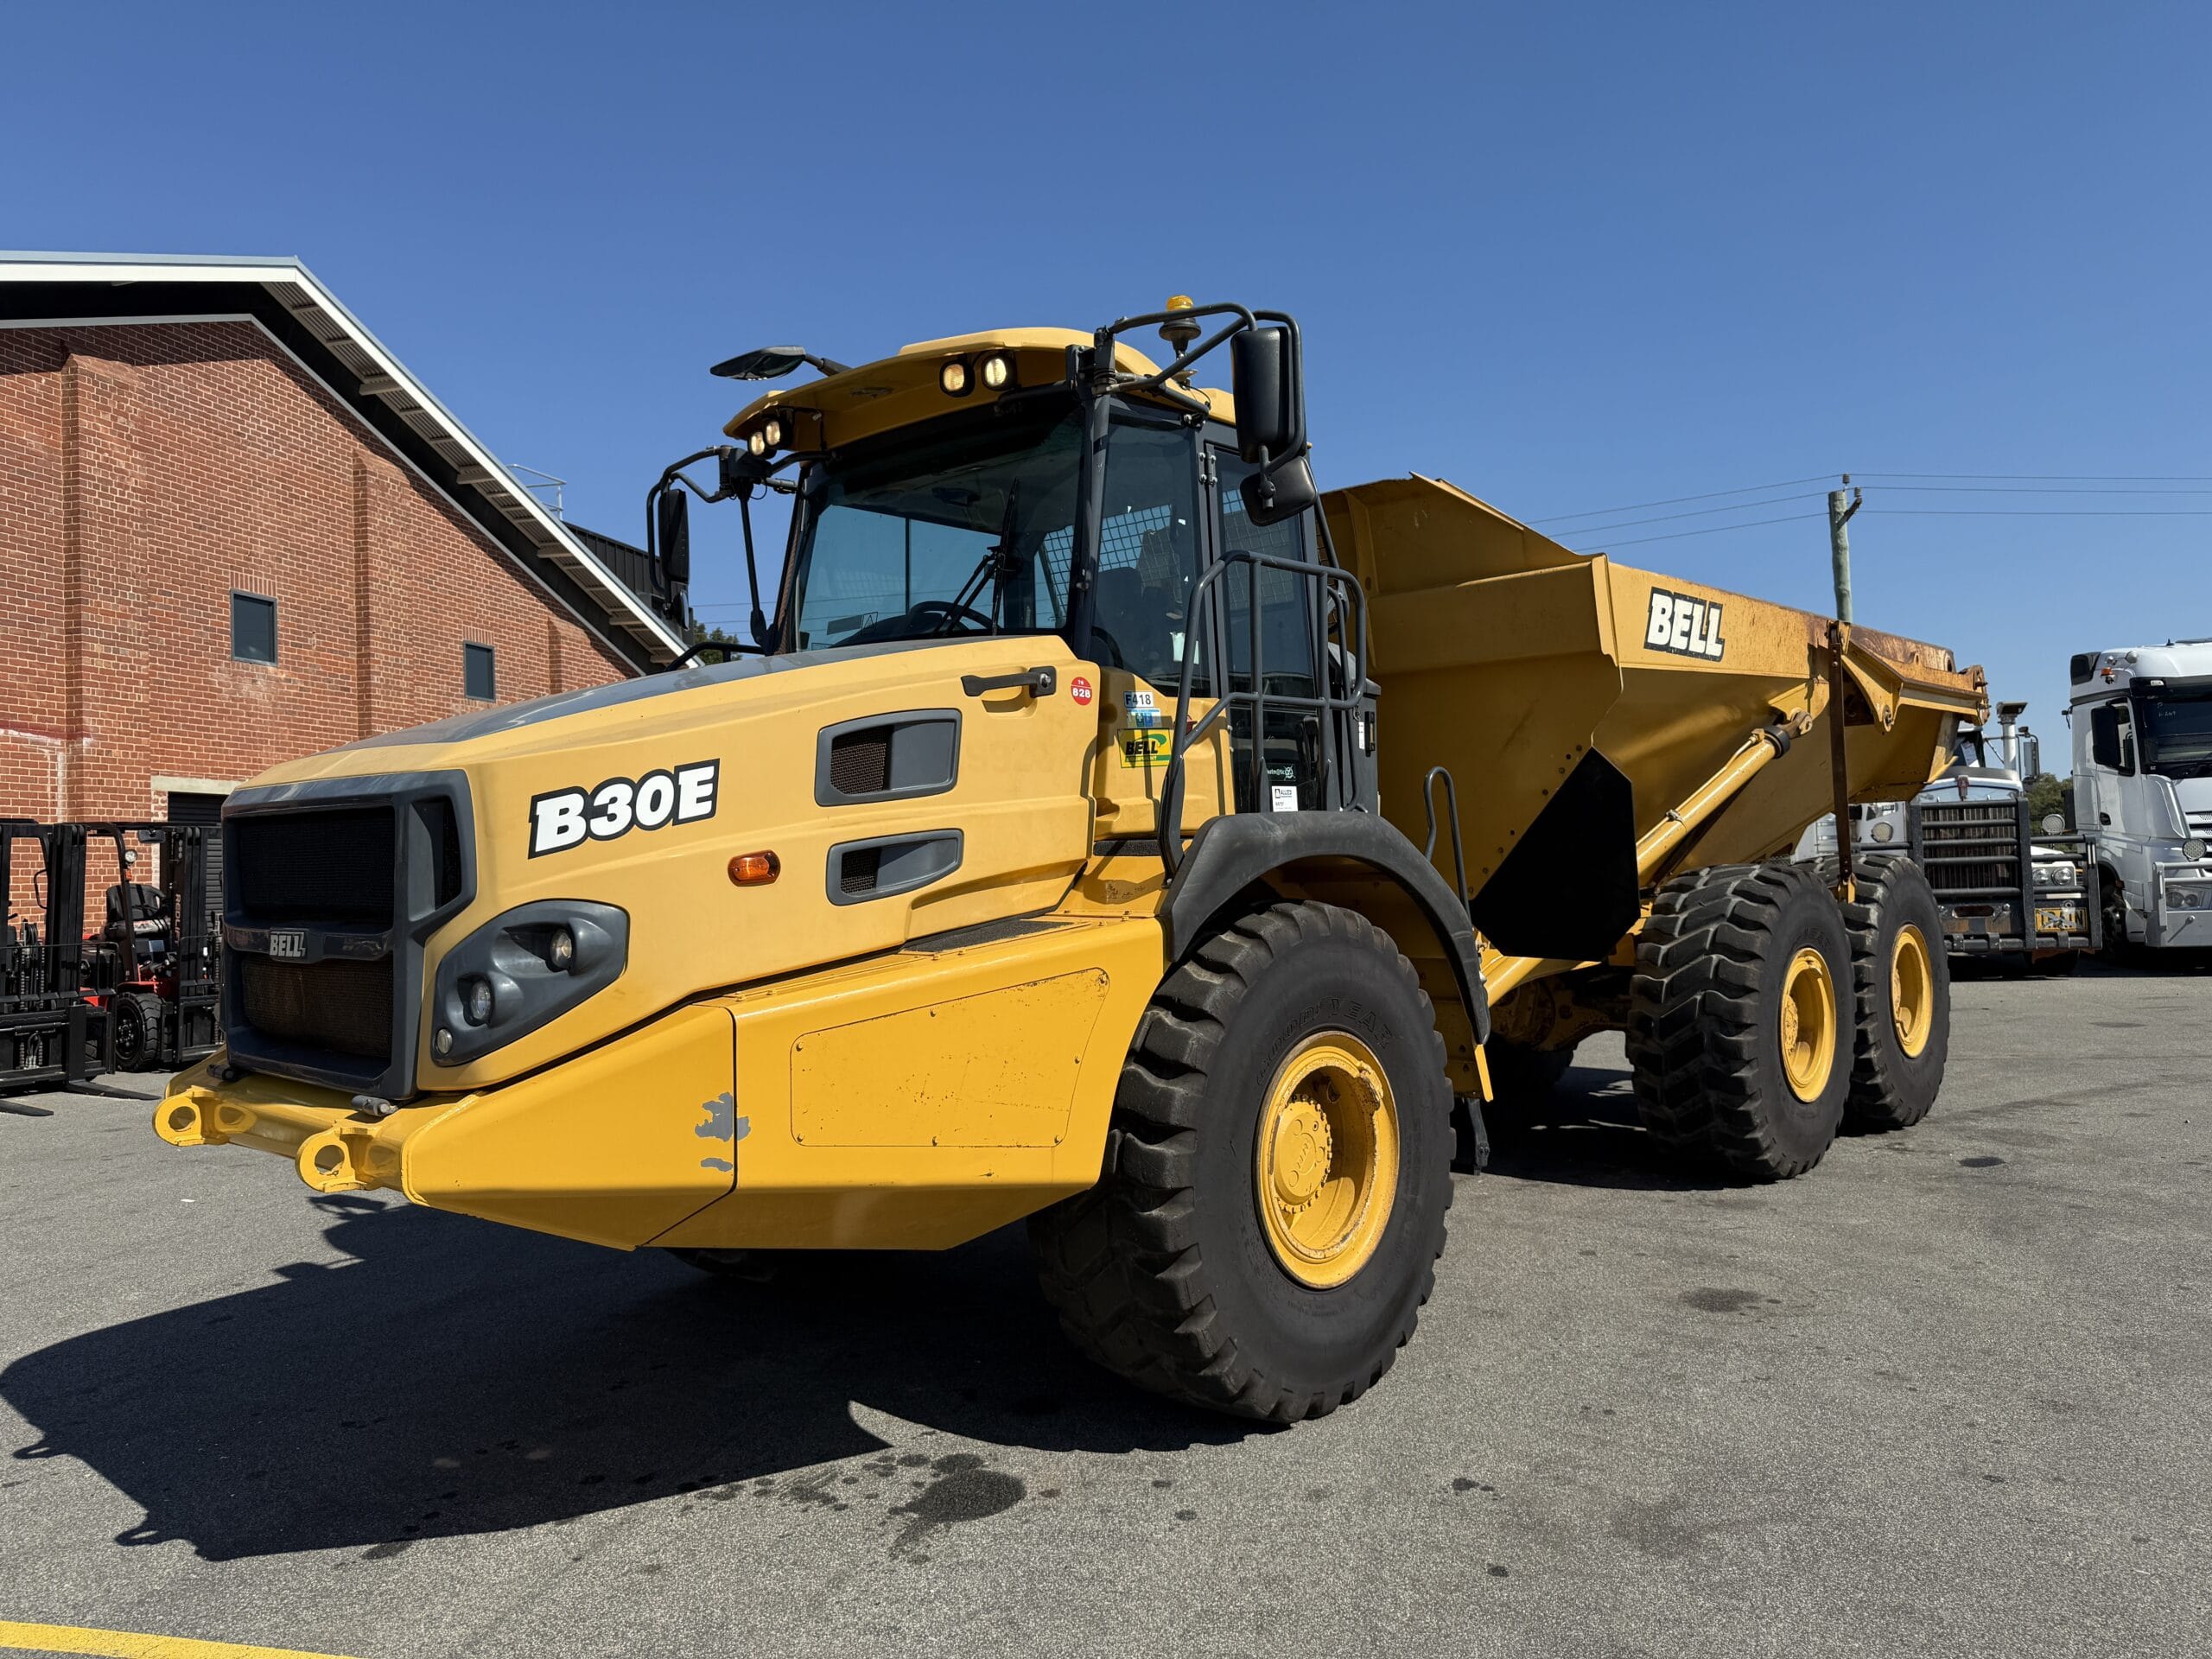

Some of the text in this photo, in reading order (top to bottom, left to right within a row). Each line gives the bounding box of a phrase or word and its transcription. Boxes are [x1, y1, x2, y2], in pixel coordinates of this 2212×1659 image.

[1645, 588, 1725, 661] BELL
[1072, 688, 1090, 698] 828
[1125, 694, 1152, 706] F418
[1125, 741, 1158, 755] BELL
[530, 760, 719, 858] B30E
[270, 932, 304, 957] BELL
